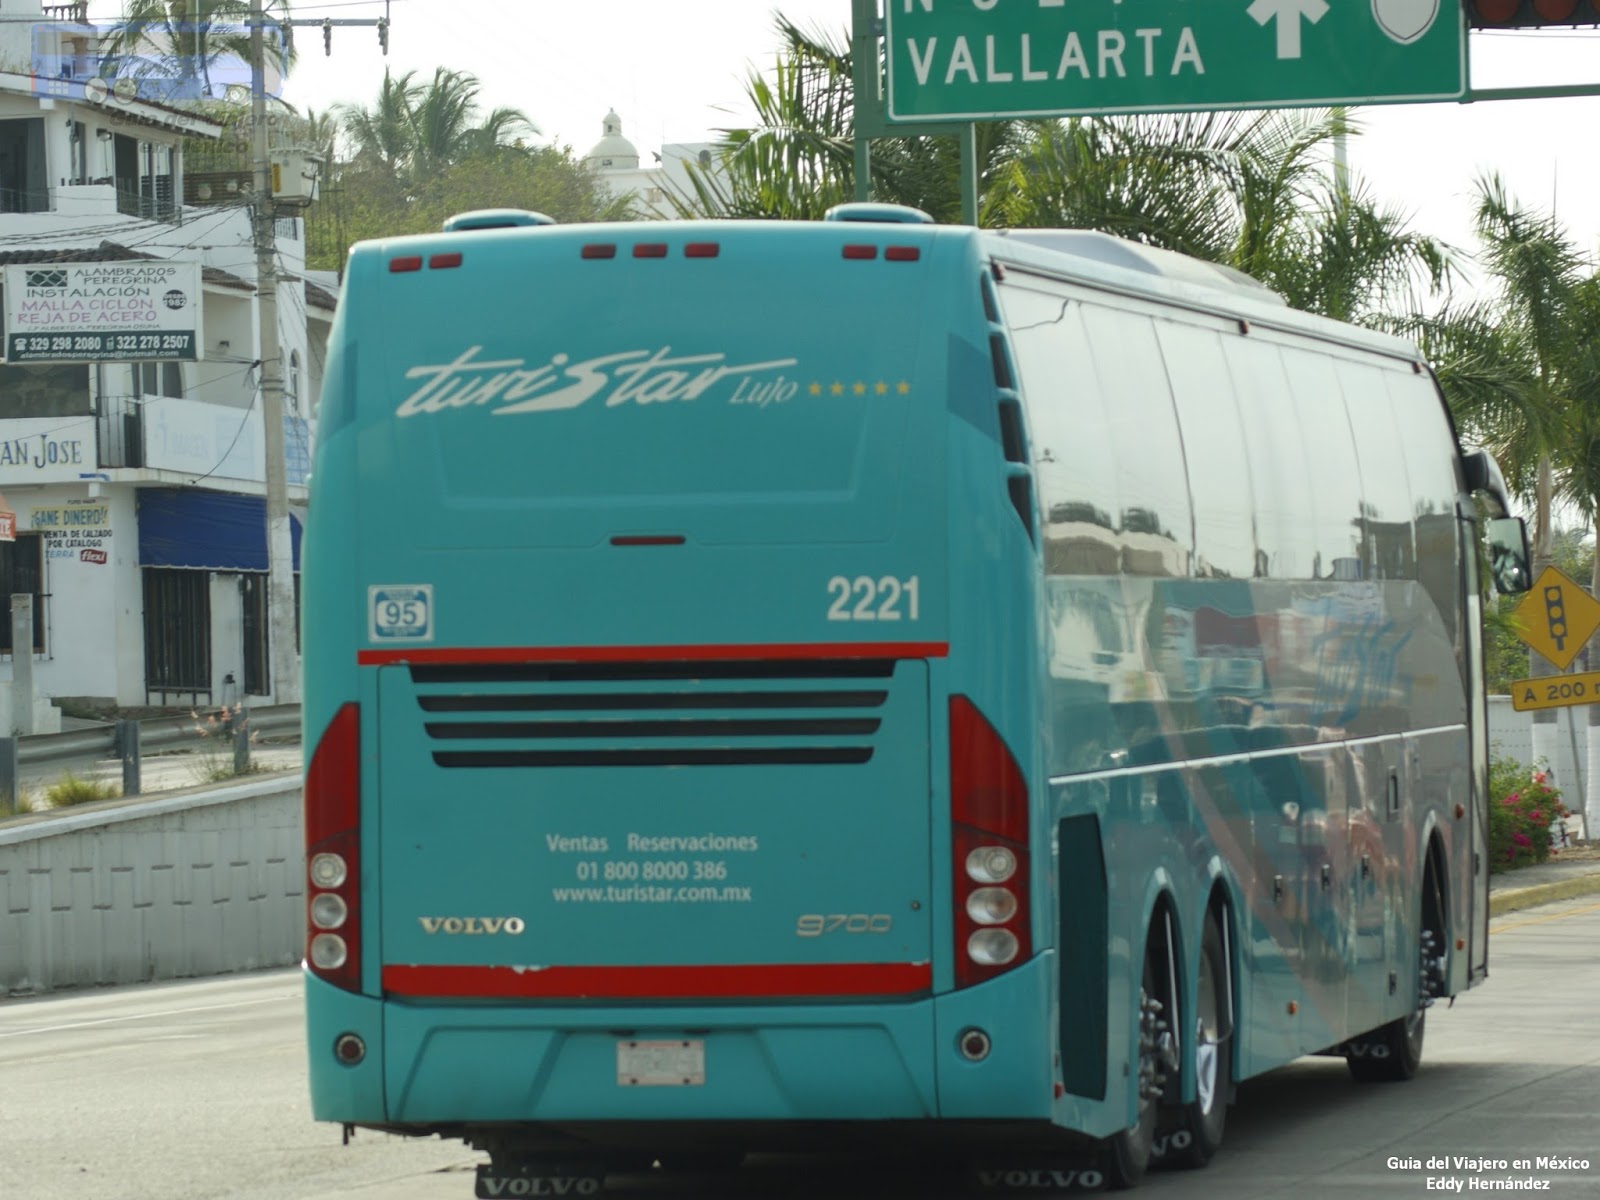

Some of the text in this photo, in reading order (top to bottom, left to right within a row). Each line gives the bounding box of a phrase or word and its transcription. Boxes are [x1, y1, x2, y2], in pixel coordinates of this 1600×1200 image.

[907, 27, 1205, 86] VALLARTA
[74, 267, 177, 278] ALAMBRADOS
[83, 276, 168, 285] PEREGRINA
[26, 285, 150, 298] INSTALACIÓN
[21, 295, 153, 312] MALLA CICLÓN
[17, 311, 157, 324] REJA DE ACERO
[29, 337, 101, 350] 329 298 2080
[116, 335, 190, 349] 322 278 2507
[20, 350, 179, 359] alambradosperegrina@hotmail.com
[729, 374, 798, 408] Lujo
[34, 433, 82, 468] JOSE
[44, 529, 112, 539] VENTA DE CALZADO
[48, 539, 103, 548] POR CATALOGO
[827, 576, 920, 621] 2221
[385, 602, 417, 624] 95
[1523, 687, 1537, 703] A
[1546, 681, 1585, 700] 200
[546, 832, 758, 851] Ventas Reservaciones
[576, 861, 727, 880] 01 800 8000 386
[552, 884, 752, 903] www.turistar.com.mx
[418, 916, 525, 935] VOLVO
[796, 914, 892, 937] 9700
[480, 1176, 598, 1197] VOLVO
[976, 1169, 1104, 1189] VOLVO
